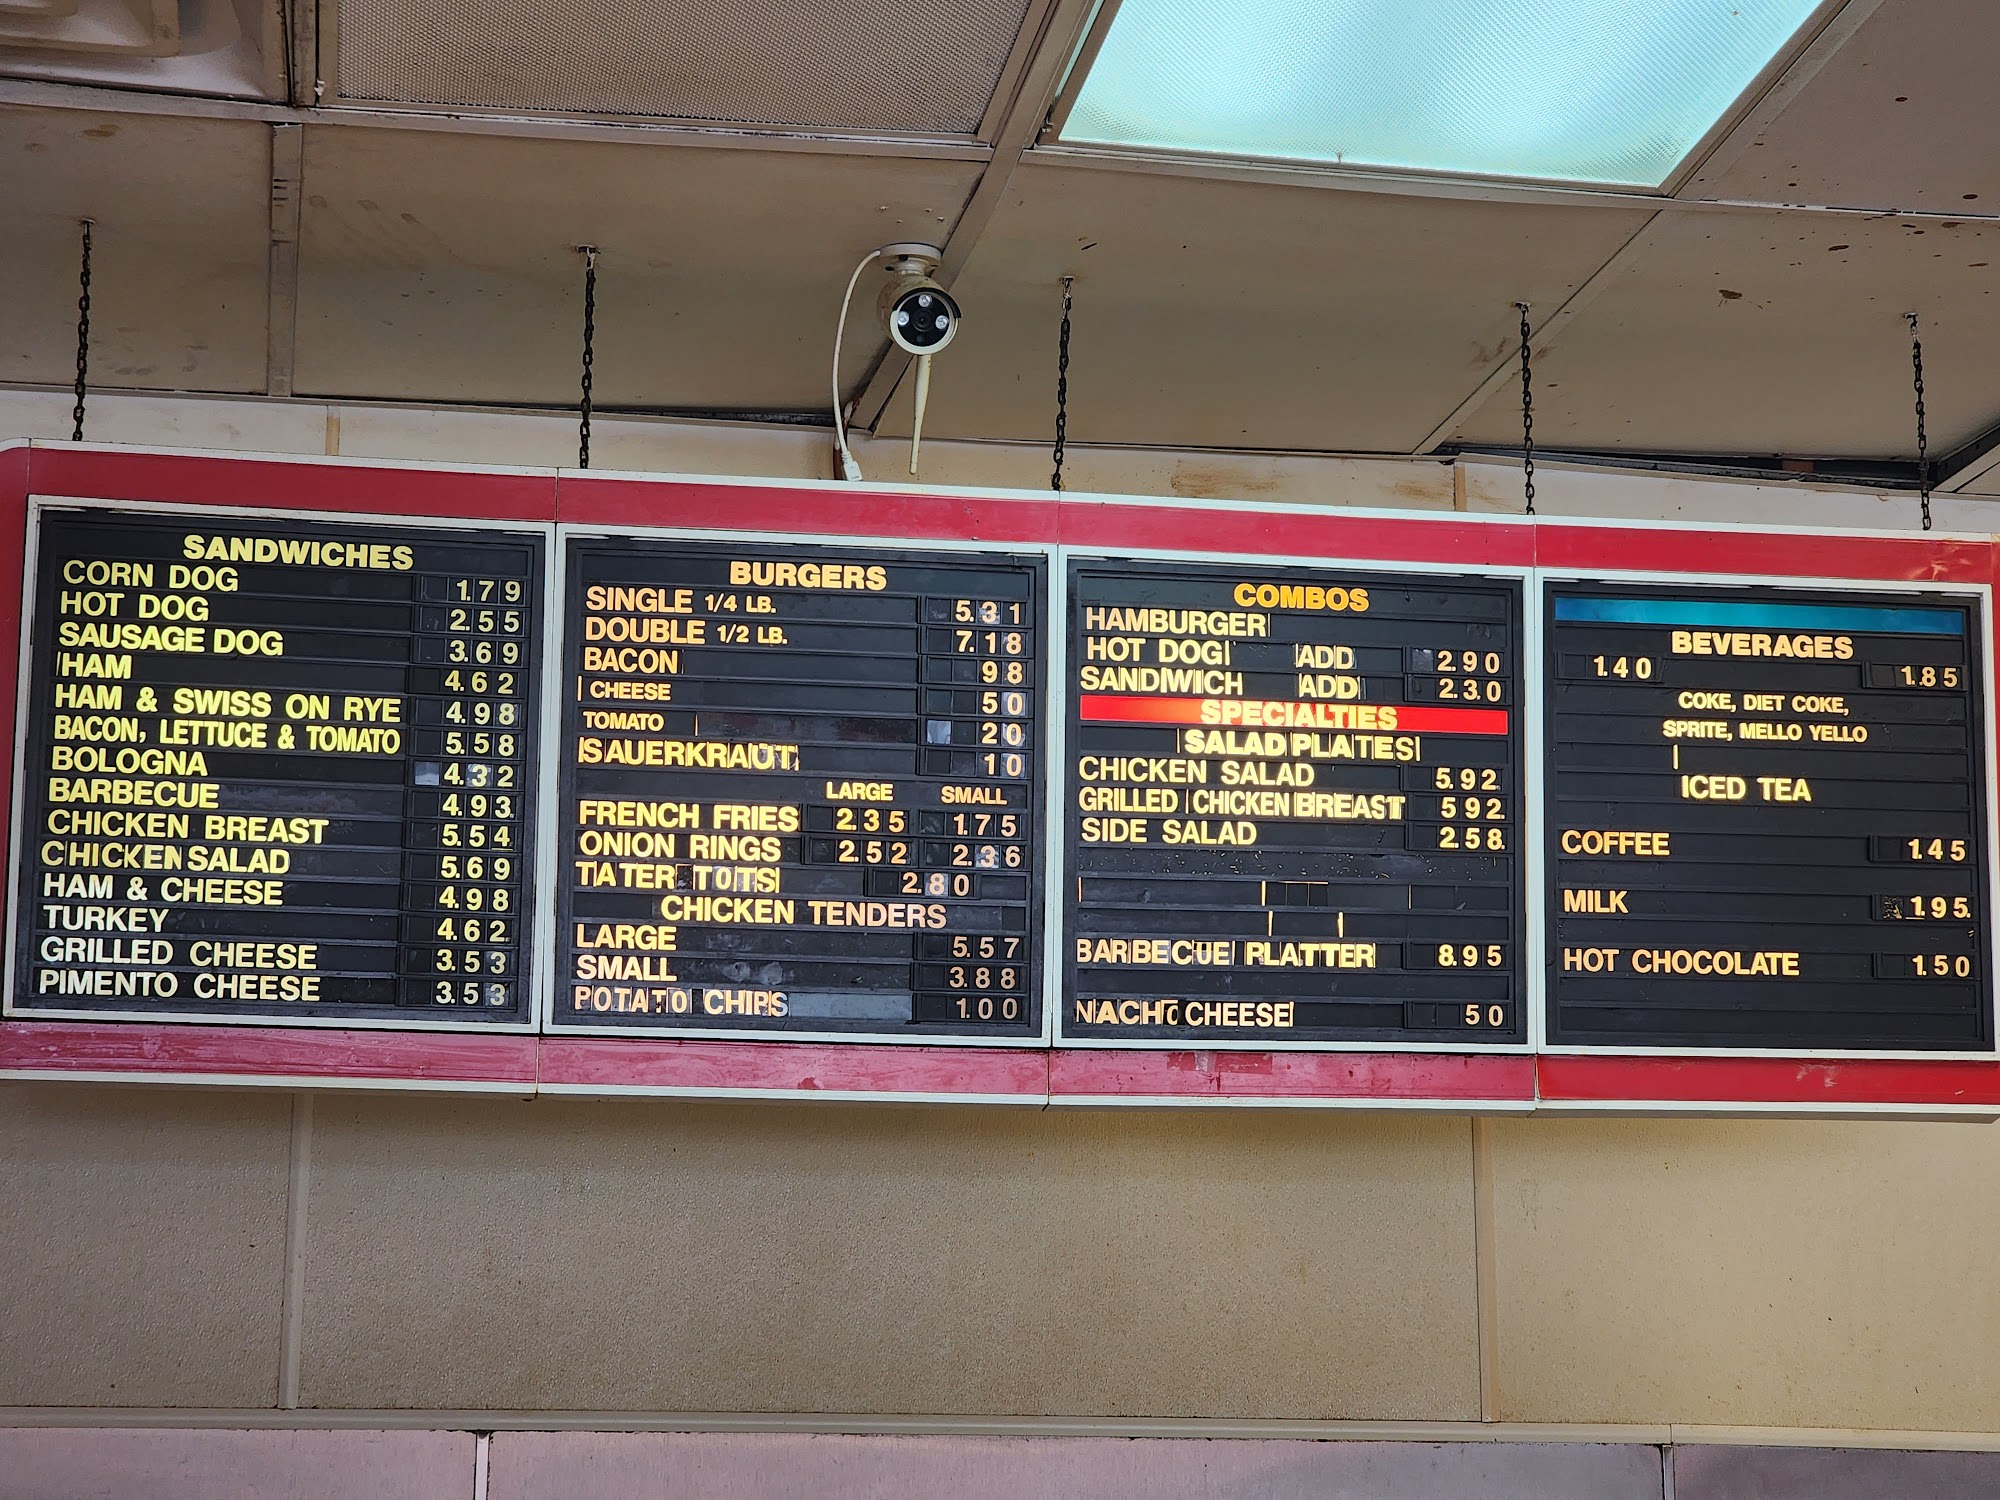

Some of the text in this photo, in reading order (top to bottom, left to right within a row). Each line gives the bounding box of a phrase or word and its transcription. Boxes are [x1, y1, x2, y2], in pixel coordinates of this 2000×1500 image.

[183, 534, 414, 571] SANDWICHES
[63, 560, 154, 588] CORN
[168, 565, 239, 592] DOG
[729, 561, 888, 591] BURGERS
[60, 591, 124, 616] HOT
[138, 594, 209, 621] DOG
[585, 586, 694, 613] SINGLE
[705, 594, 737, 613] 1/4
[746, 596, 776, 614] LB.
[1233, 583, 1370, 612] COMBOS
[585, 616, 706, 645] DOUBLE
[717, 624, 750, 643] 1/2
[757, 626, 788, 645] LB.
[1085, 607, 1267, 637] HAMBURGER
[58, 622, 205, 653] SAUSAGE
[213, 629, 284, 655] DOG
[1086, 637, 1145, 662] HOT
[1158, 639, 1225, 665] DOG
[1298, 645, 1354, 669] ADD
[1671, 631, 1854, 660] BEVERAGES
[62, 653, 132, 679] HAM
[583, 647, 678, 674] BACON
[589, 680, 672, 701] CHEESE
[1080, 666, 1243, 696] SANDWICH
[1299, 673, 1358, 699] ADD
[55, 684, 122, 711] HAM
[136, 688, 157, 713] &
[173, 689, 272, 718] SWISS
[285, 694, 330, 719] ON
[344, 697, 401, 723] RYE
[1200, 699, 1398, 731] SPECIALTIES
[1678, 692, 1849, 716] COKE, DIET COKE,
[53, 715, 147, 745] BACON,
[160, 719, 267, 749] LETTUCE
[277, 725, 295, 749] &
[309, 726, 400, 755] TOMATO
[583, 712, 664, 731] TOMATO
[1662, 720, 1868, 743] SPRITE, MELLO YELLO
[582, 736, 795, 769] SAUERKRAUT
[1184, 728, 1415, 761] SALAD PLATES
[51, 748, 208, 777] BOLOGNA
[1078, 756, 1207, 784] CHICKEN
[1221, 761, 1315, 787] SALAD
[48, 778, 220, 809] BARBECUE
[826, 781, 1007, 805] LARGE SMALL
[1681, 775, 1812, 802] ICED TEA
[579, 800, 699, 828] FRENCH
[713, 804, 799, 832] FRIES
[1078, 787, 1178, 814] GRILLED
[1193, 790, 1289, 816] CHICKEN
[1298, 792, 1405, 821] BREAST
[47, 809, 189, 838] CHICKEN
[205, 816, 329, 844] BREAST
[1080, 818, 1148, 843] SIDE
[1162, 820, 1257, 846] SALAD
[40, 841, 182, 871] CHICKEN
[187, 846, 290, 874] SALAD
[580, 831, 675, 858] ONION
[689, 836, 782, 863] RINGS
[1561, 830, 1670, 856] COFFEE
[43, 874, 113, 899] HAM
[126, 876, 148, 901] &
[161, 877, 284, 905] CHEESE
[575, 861, 675, 889] TATER
[697, 865, 776, 893] TOTS
[661, 895, 947, 929] CHICKEN TENDERS
[1563, 889, 1628, 914] MILK
[42, 905, 169, 933] TURKEY
[576, 924, 677, 951] LARGE
[39, 936, 173, 965] GRILLED
[189, 941, 317, 970] CHEESE
[1077, 938, 1230, 967] BARBECUE
[1246, 941, 1374, 968] PLATTER
[1563, 948, 1620, 972] HOT
[1631, 950, 1800, 976] CHOCOLATE
[576, 955, 677, 982] SMALL
[38, 970, 178, 997] PIMENTO
[193, 974, 321, 1002] CHEESE
[574, 985, 688, 1015] POTATO
[703, 989, 789, 1017] CHIPS
[1184, 1001, 1290, 1028] CHEESE
